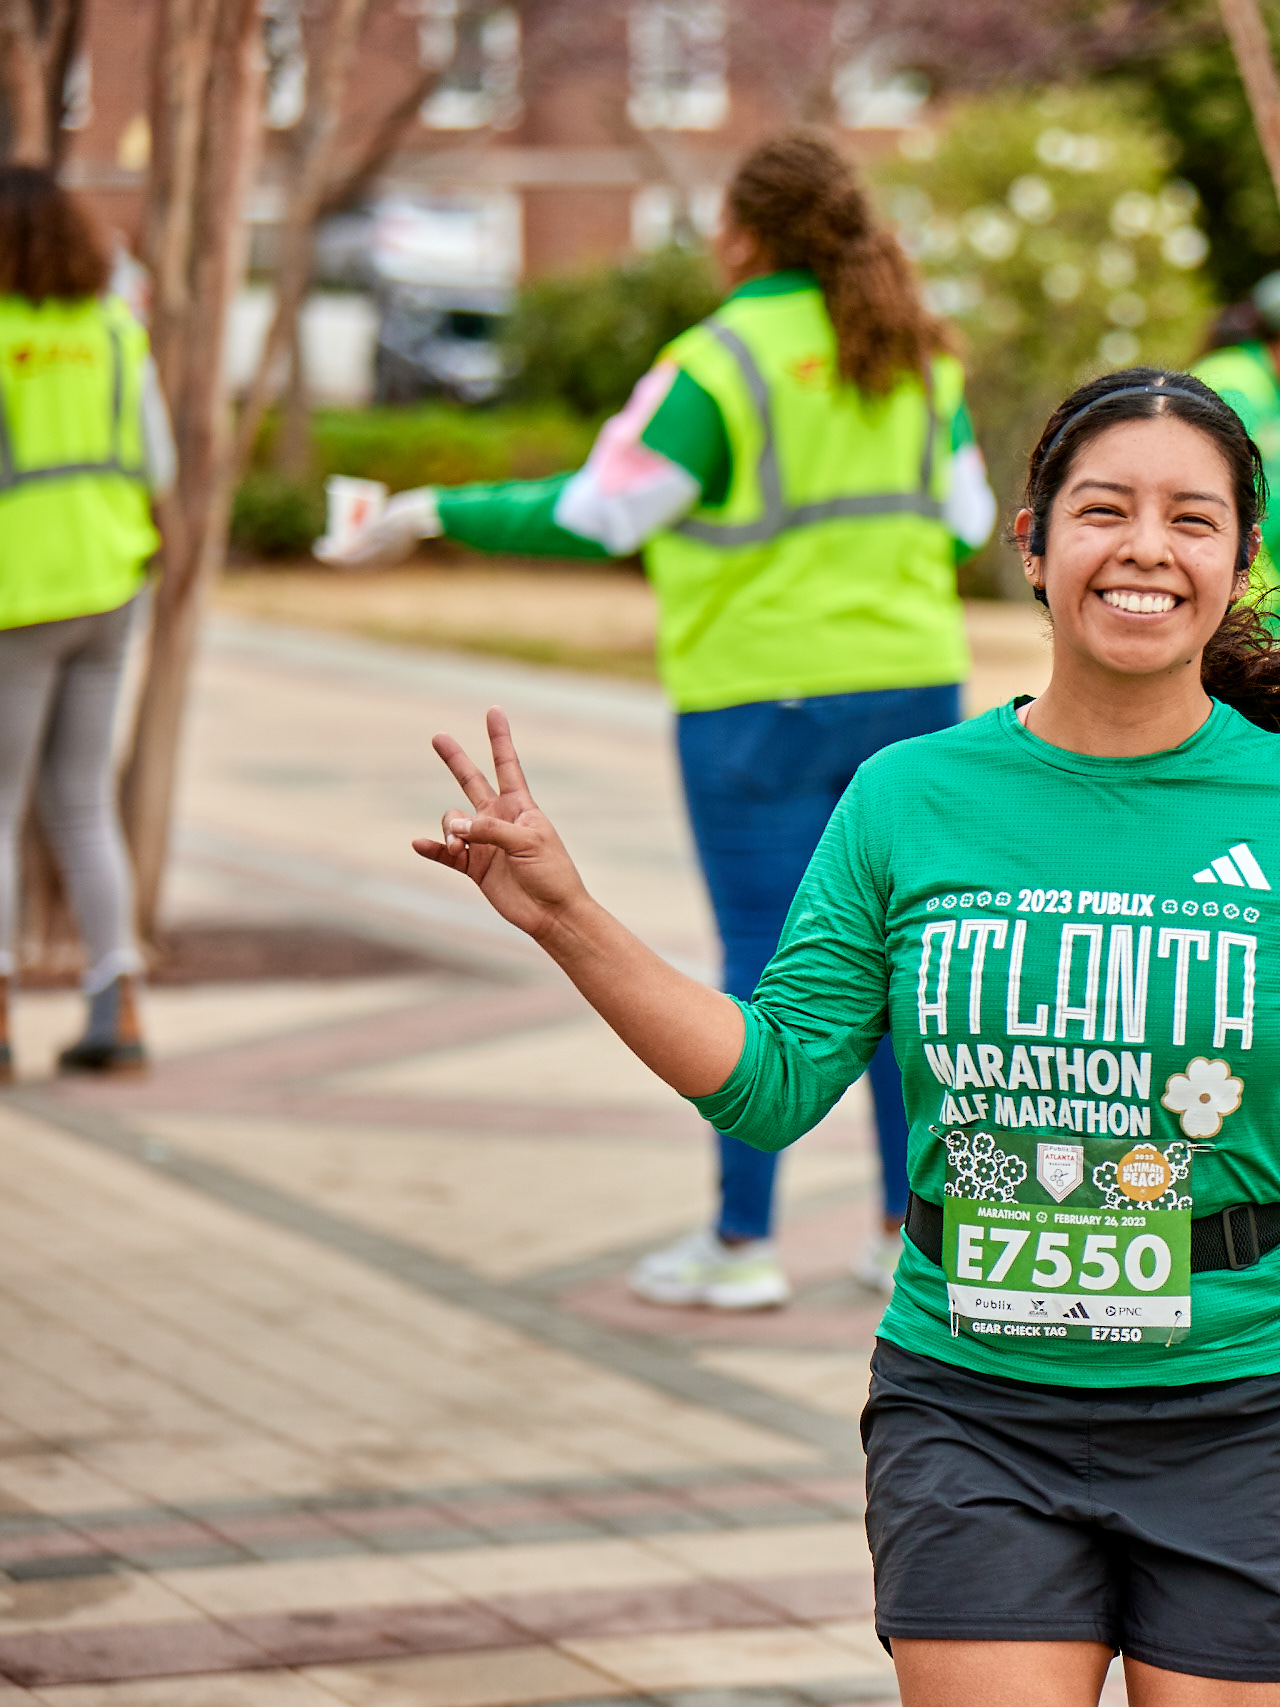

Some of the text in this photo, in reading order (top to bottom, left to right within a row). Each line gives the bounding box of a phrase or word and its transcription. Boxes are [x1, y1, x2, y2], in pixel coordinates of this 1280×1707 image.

[1016, 888, 1155, 917] 2023 PUBLIX
[917, 918, 1258, 1050] ATLANTA
[923, 1043, 1153, 1100] MARATHON
[994, 1092, 1151, 1138] MARATHON
[1045, 1153, 1075, 1161] ATLANTA
[1122, 1161, 1165, 1174] ULTIMATE
[1122, 1172, 1165, 1187] PEACH
[977, 1206, 1147, 1227] MARATHON FEBRUARY 26, 2023
[956, 1223, 1172, 1292] E7550
[975, 1298, 1012, 1311] Publix
[1119, 1306, 1143, 1317] PNC
[972, 1321, 1068, 1337] GEAR CHECK TAG
[1091, 1327, 1143, 1342] E7550
